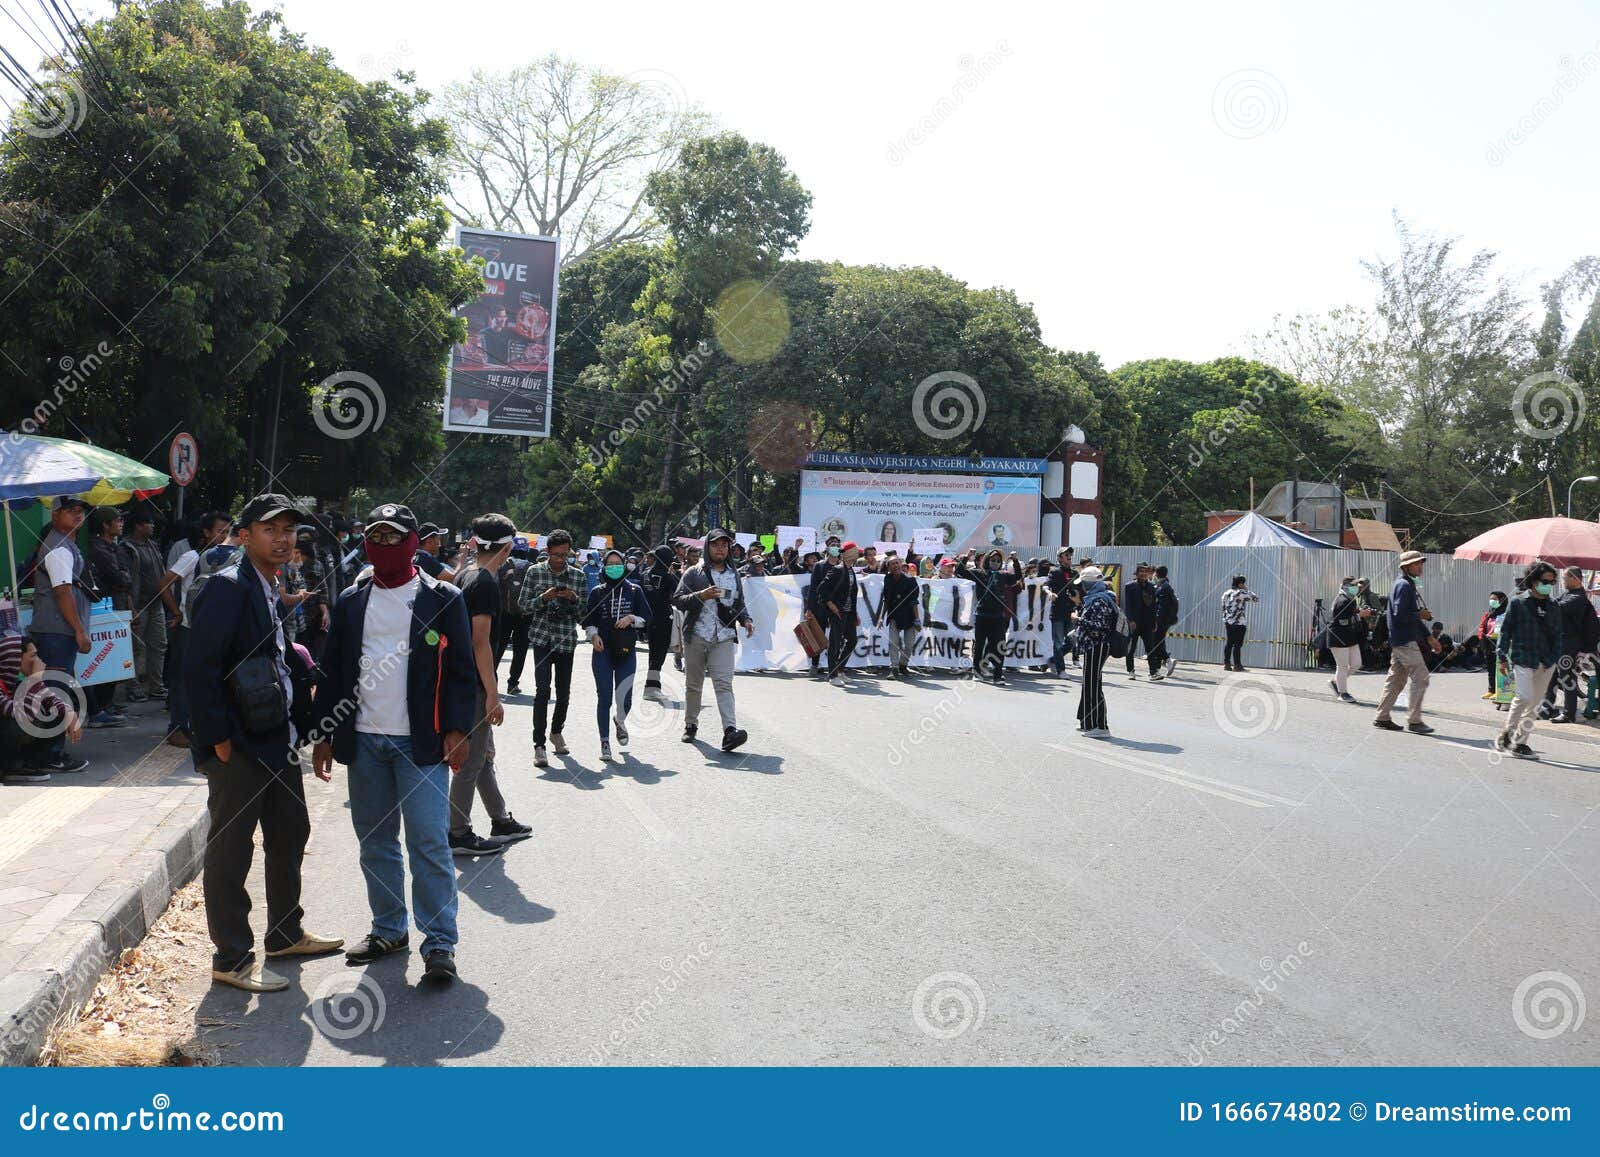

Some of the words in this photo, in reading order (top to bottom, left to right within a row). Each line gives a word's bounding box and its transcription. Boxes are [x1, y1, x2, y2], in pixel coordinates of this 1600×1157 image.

[487, 374, 500, 387] THE
[502, 375, 520, 387] REAL
[520, 378, 542, 390] MOVE
[178, 443, 190, 474] P
[805, 452, 859, 467] PUBLIKASI
[861, 456, 928, 468] UNIVERSITAS
[929, 459, 966, 469] NEGERI
[833, 479, 870, 487] International
[907, 480, 933, 488] Science
[933, 481, 965, 489] Education
[870, 500, 905, 508] Revolution
